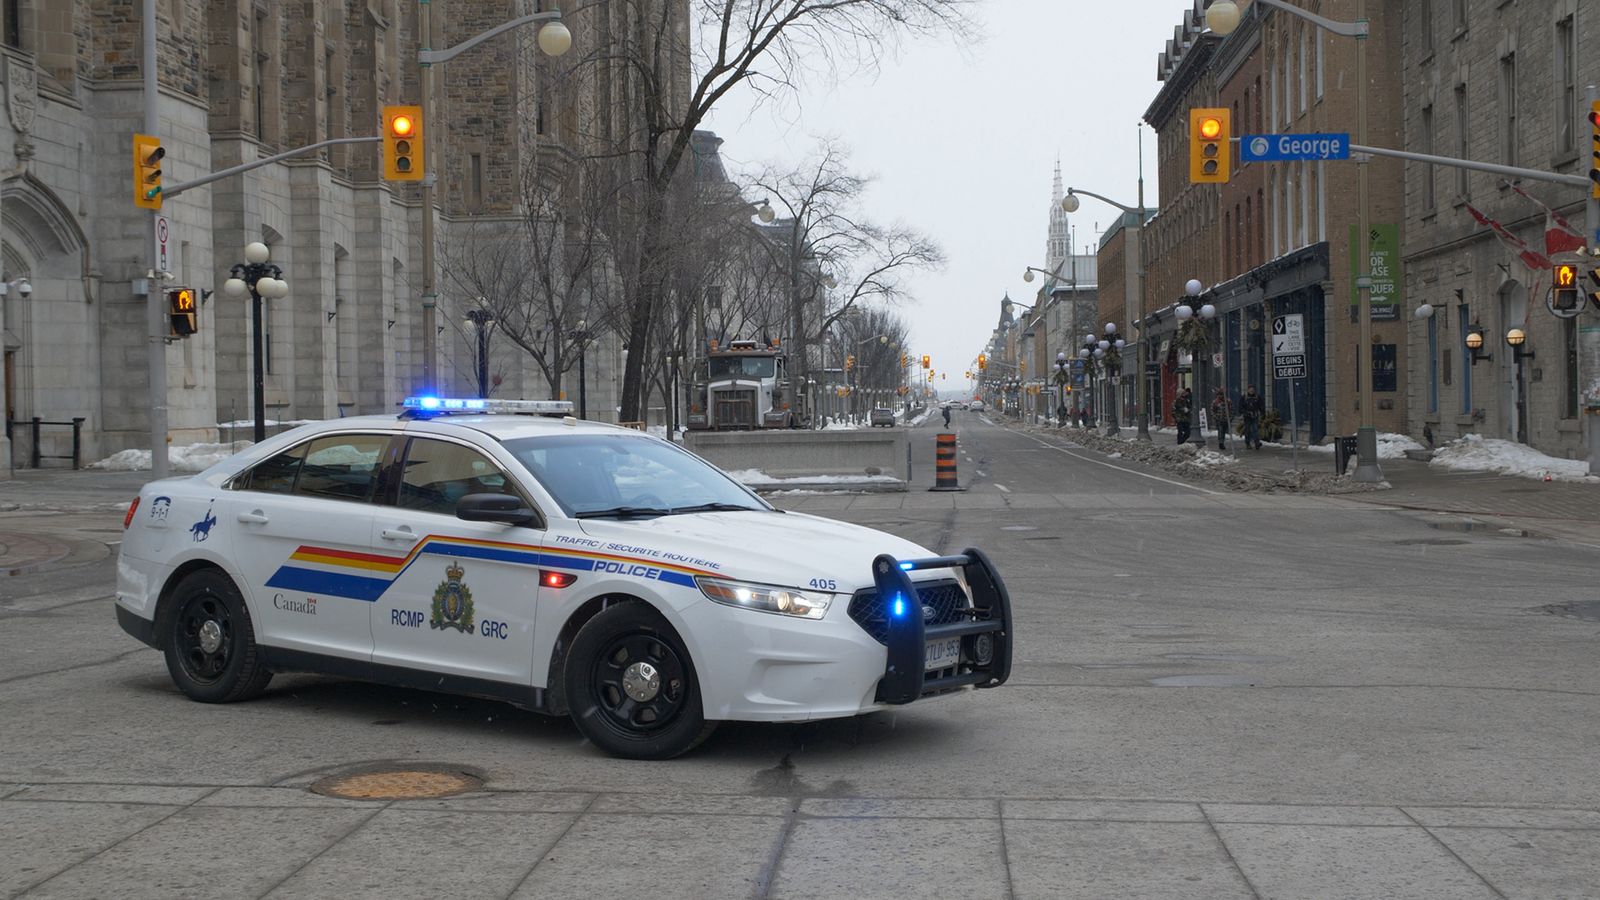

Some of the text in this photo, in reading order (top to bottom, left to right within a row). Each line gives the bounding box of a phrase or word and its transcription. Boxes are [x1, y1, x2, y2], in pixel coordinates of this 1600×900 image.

[1278, 136, 1340, 158] George
[1370, 256, 1384, 267] OR
[1371, 266, 1389, 276] ASE
[1370, 284, 1394, 294] OUER
[1276, 356, 1302, 365] BEGINS
[556, 535, 599, 548] TRAFFIC
[593, 560, 660, 580] POLICE
[809, 578, 836, 590] 405
[273, 593, 316, 615] Canada
[391, 609, 424, 628] RCMP
[481, 620, 508, 639] GRC
